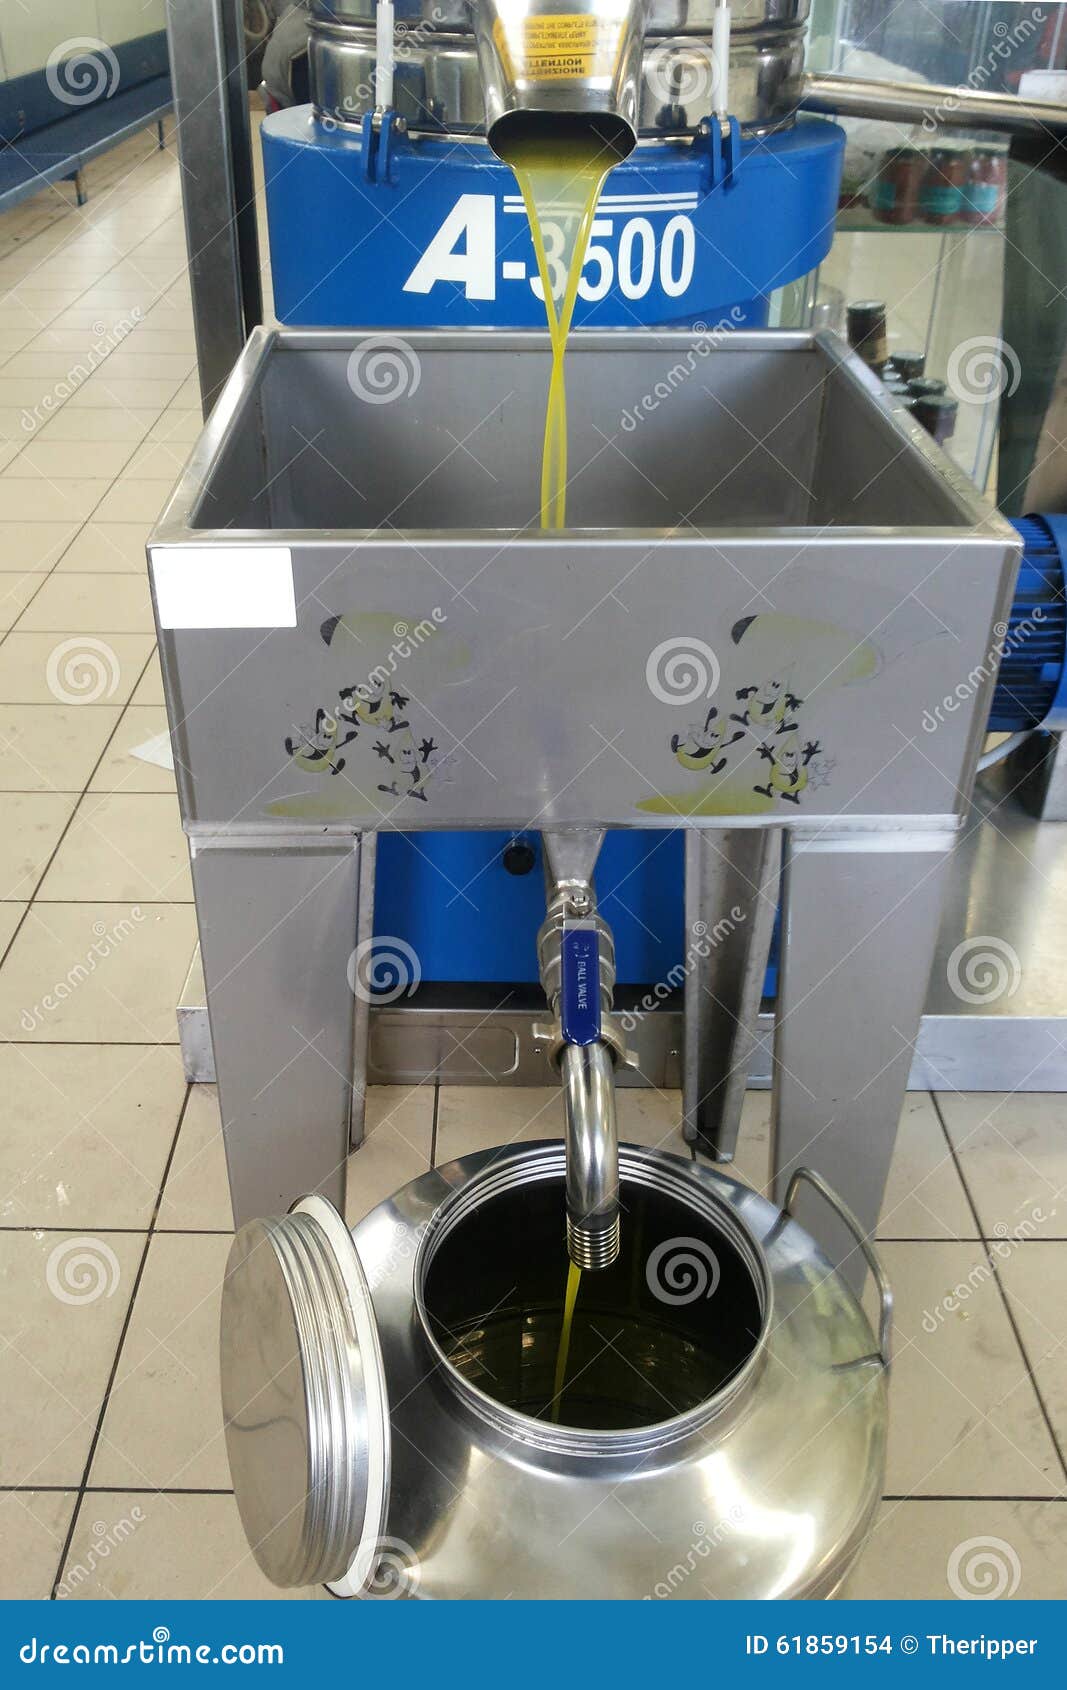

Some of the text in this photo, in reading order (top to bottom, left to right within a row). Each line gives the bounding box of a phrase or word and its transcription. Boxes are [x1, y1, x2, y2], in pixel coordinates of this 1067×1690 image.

[402, 194, 695, 301] A-3500
[577, 961, 587, 982] BALL
[578, 983, 588, 1010] VALVE
